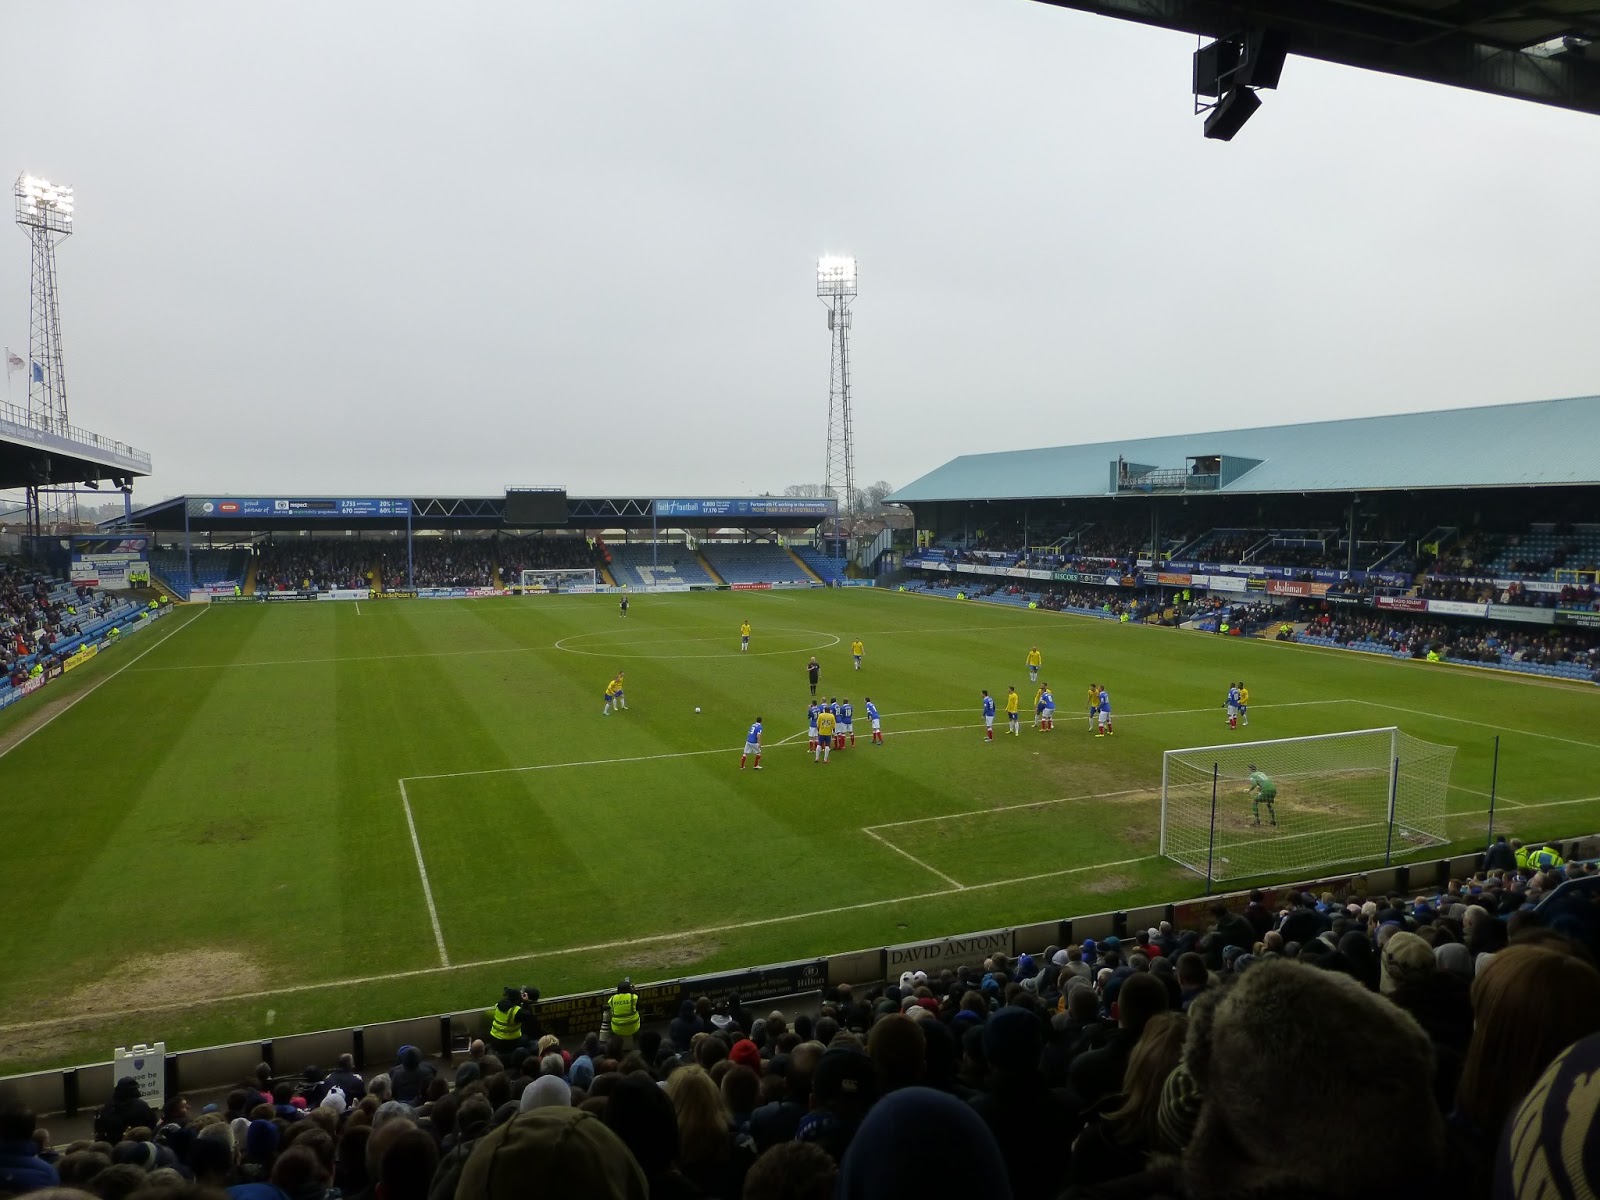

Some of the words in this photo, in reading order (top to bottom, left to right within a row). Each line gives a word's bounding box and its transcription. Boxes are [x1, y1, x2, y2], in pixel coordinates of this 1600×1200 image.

[1054, 572, 1078, 581] BISCOES
[1273, 581, 1303, 594] shalimar
[749, 726, 755, 734] 3
[891, 945, 941, 964] DAVID
[944, 933, 1011, 956] ANTONY
[797, 977, 825, 987] Hilton
